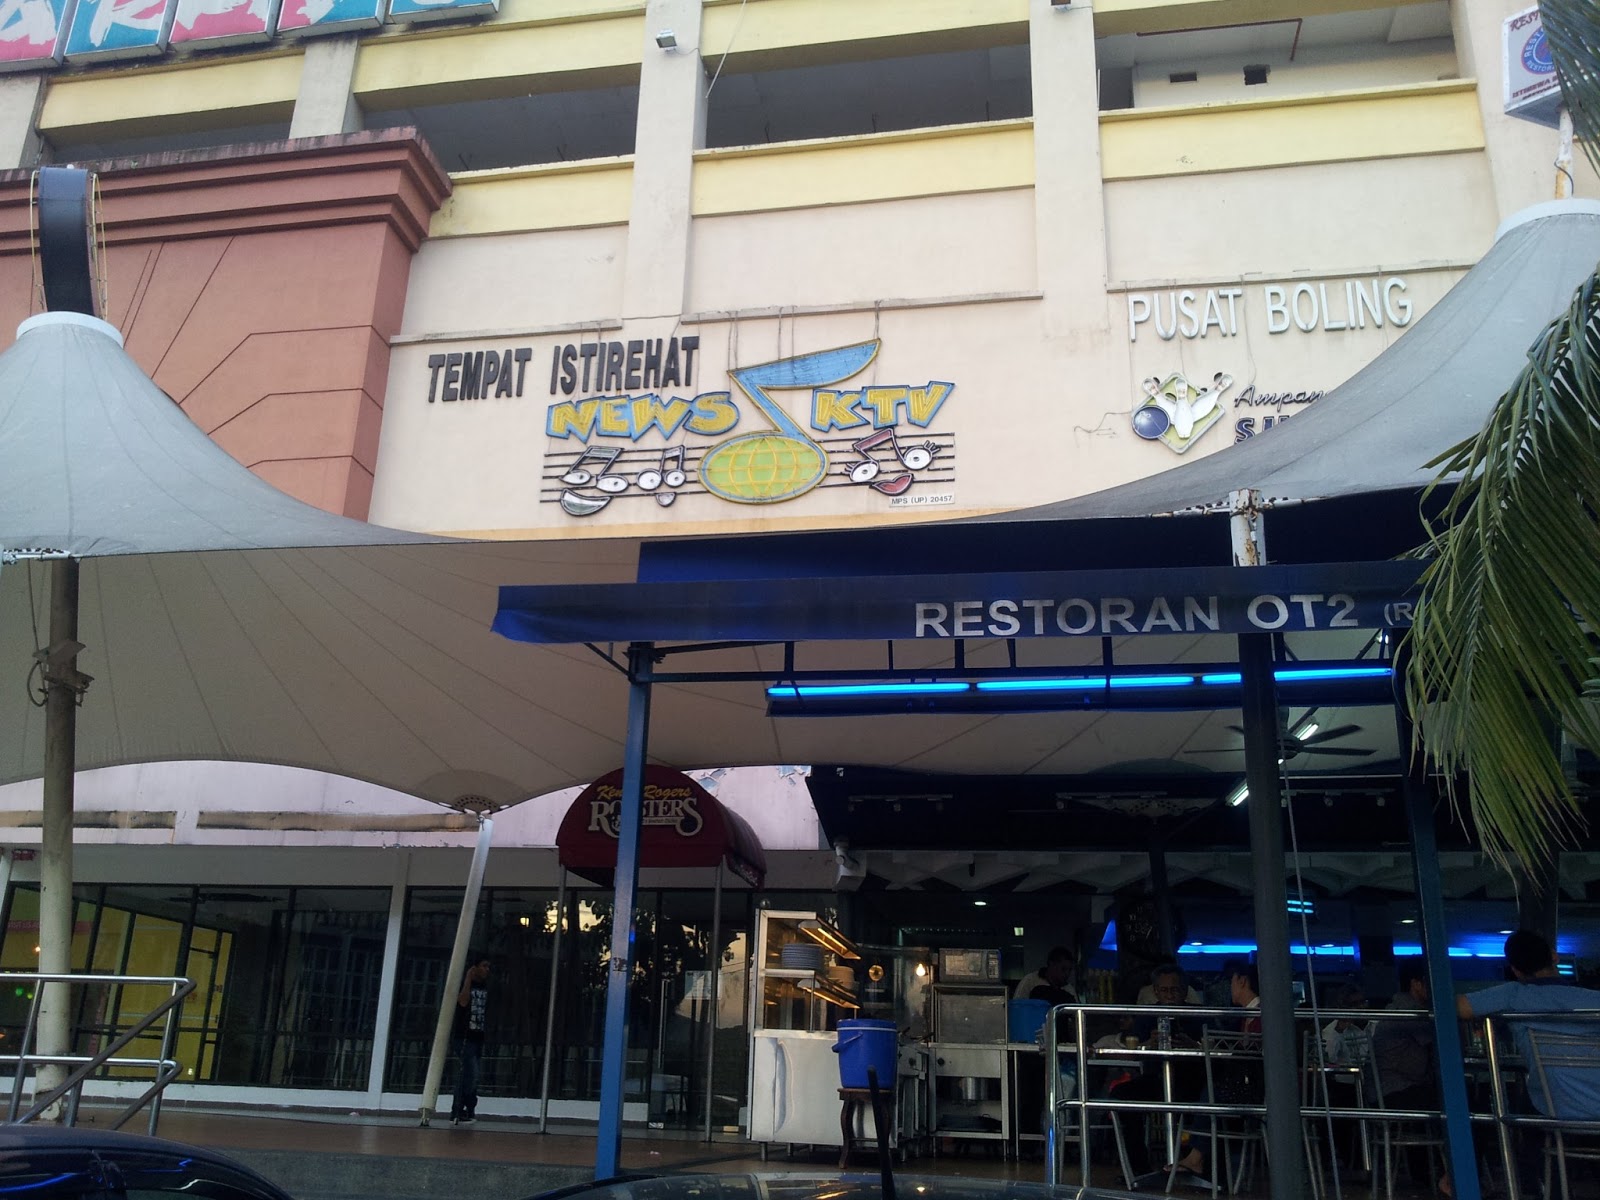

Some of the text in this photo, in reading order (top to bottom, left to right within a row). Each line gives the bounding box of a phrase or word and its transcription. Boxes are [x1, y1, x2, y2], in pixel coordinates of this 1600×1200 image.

[1127, 277, 1413, 342] PUSAT BOLING
[428, 336, 699, 404] TEMPAT ISTIREHAT
[546, 381, 955, 443] NEWS KTV
[1234, 384, 1331, 412] Ampan
[911, 496, 928, 504] (UP)
[914, 596, 1220, 637] RESTORAN
[1246, 594, 1359, 630] OT2
[643, 784, 692, 799] Rogers
